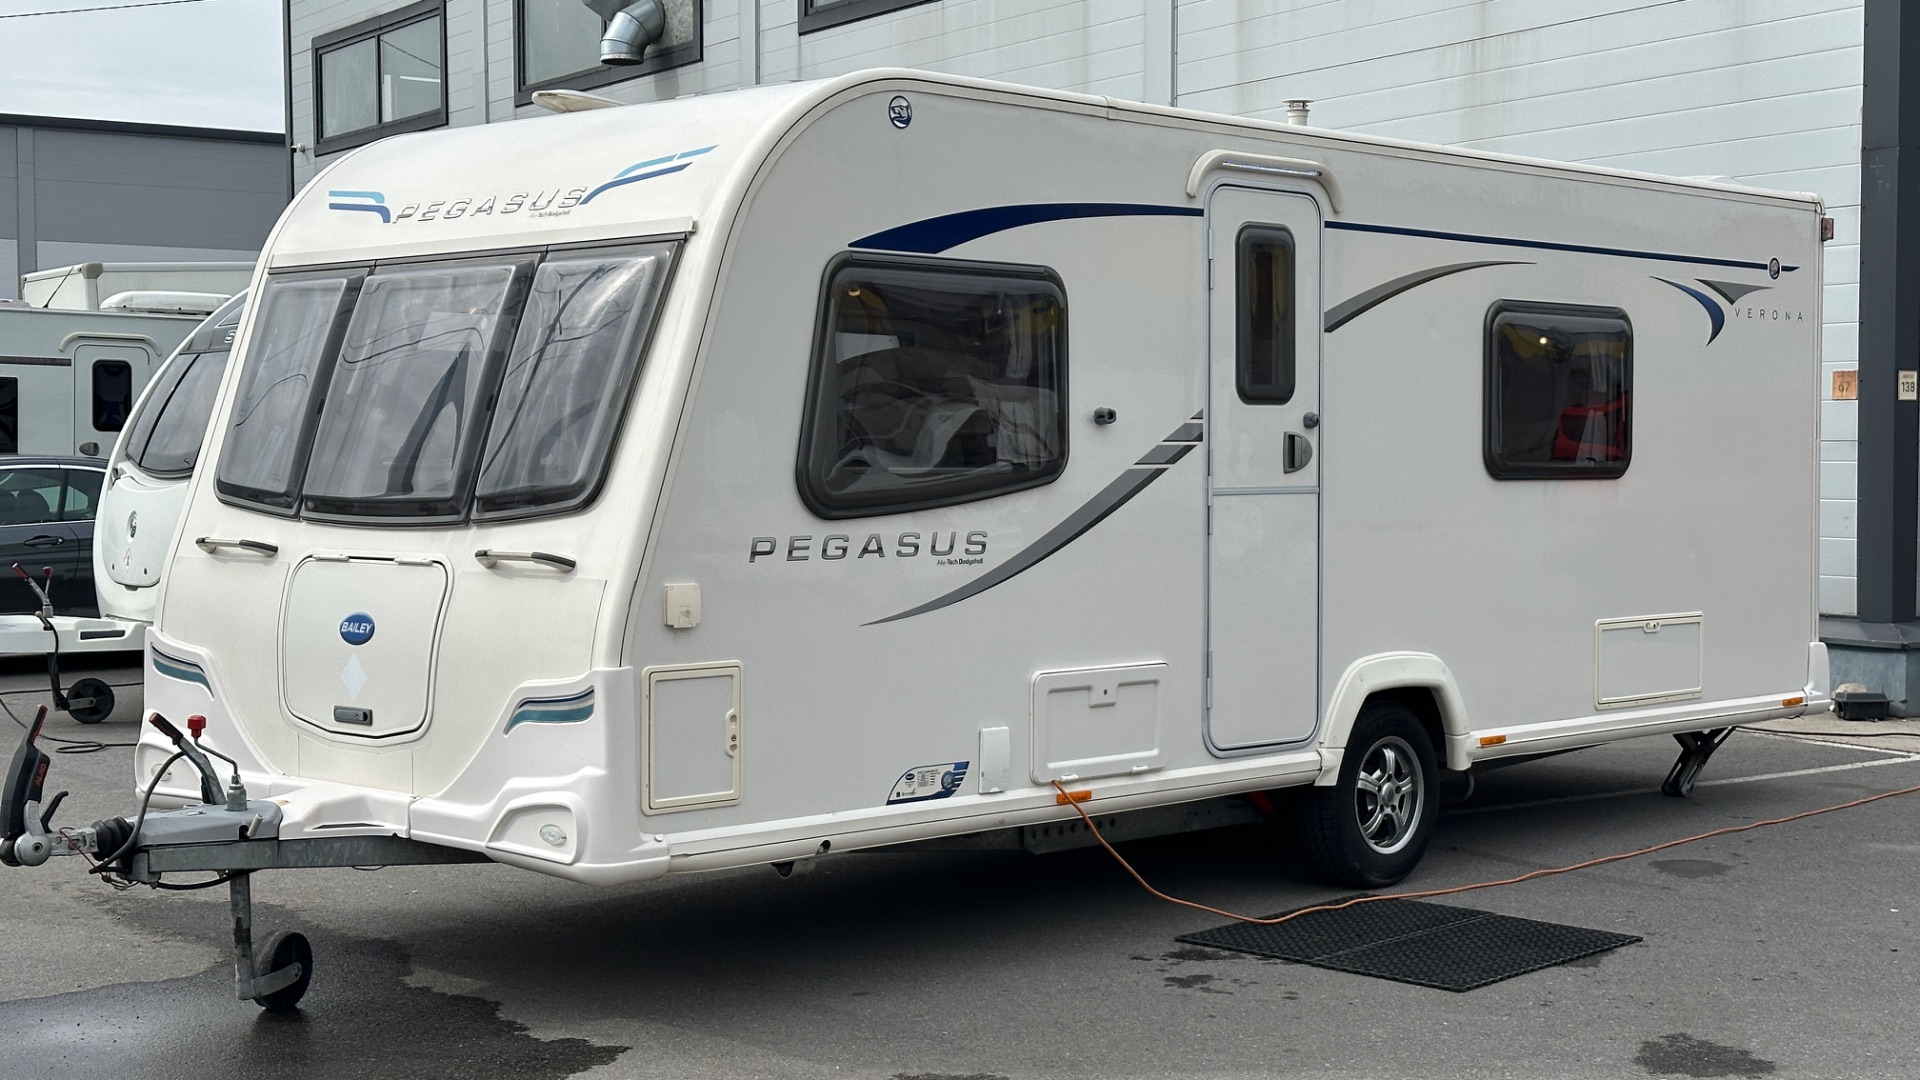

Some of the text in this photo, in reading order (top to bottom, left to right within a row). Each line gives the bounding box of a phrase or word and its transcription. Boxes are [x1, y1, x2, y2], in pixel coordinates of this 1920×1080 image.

[392, 186, 587, 223] PEGASUS
[1735, 307, 1803, 321] VERONA
[1838, 381, 1850, 392] 67
[1901, 381, 1915, 393] 138
[749, 530, 988, 563] PEGASUS
[341, 621, 372, 633] BAILEY
